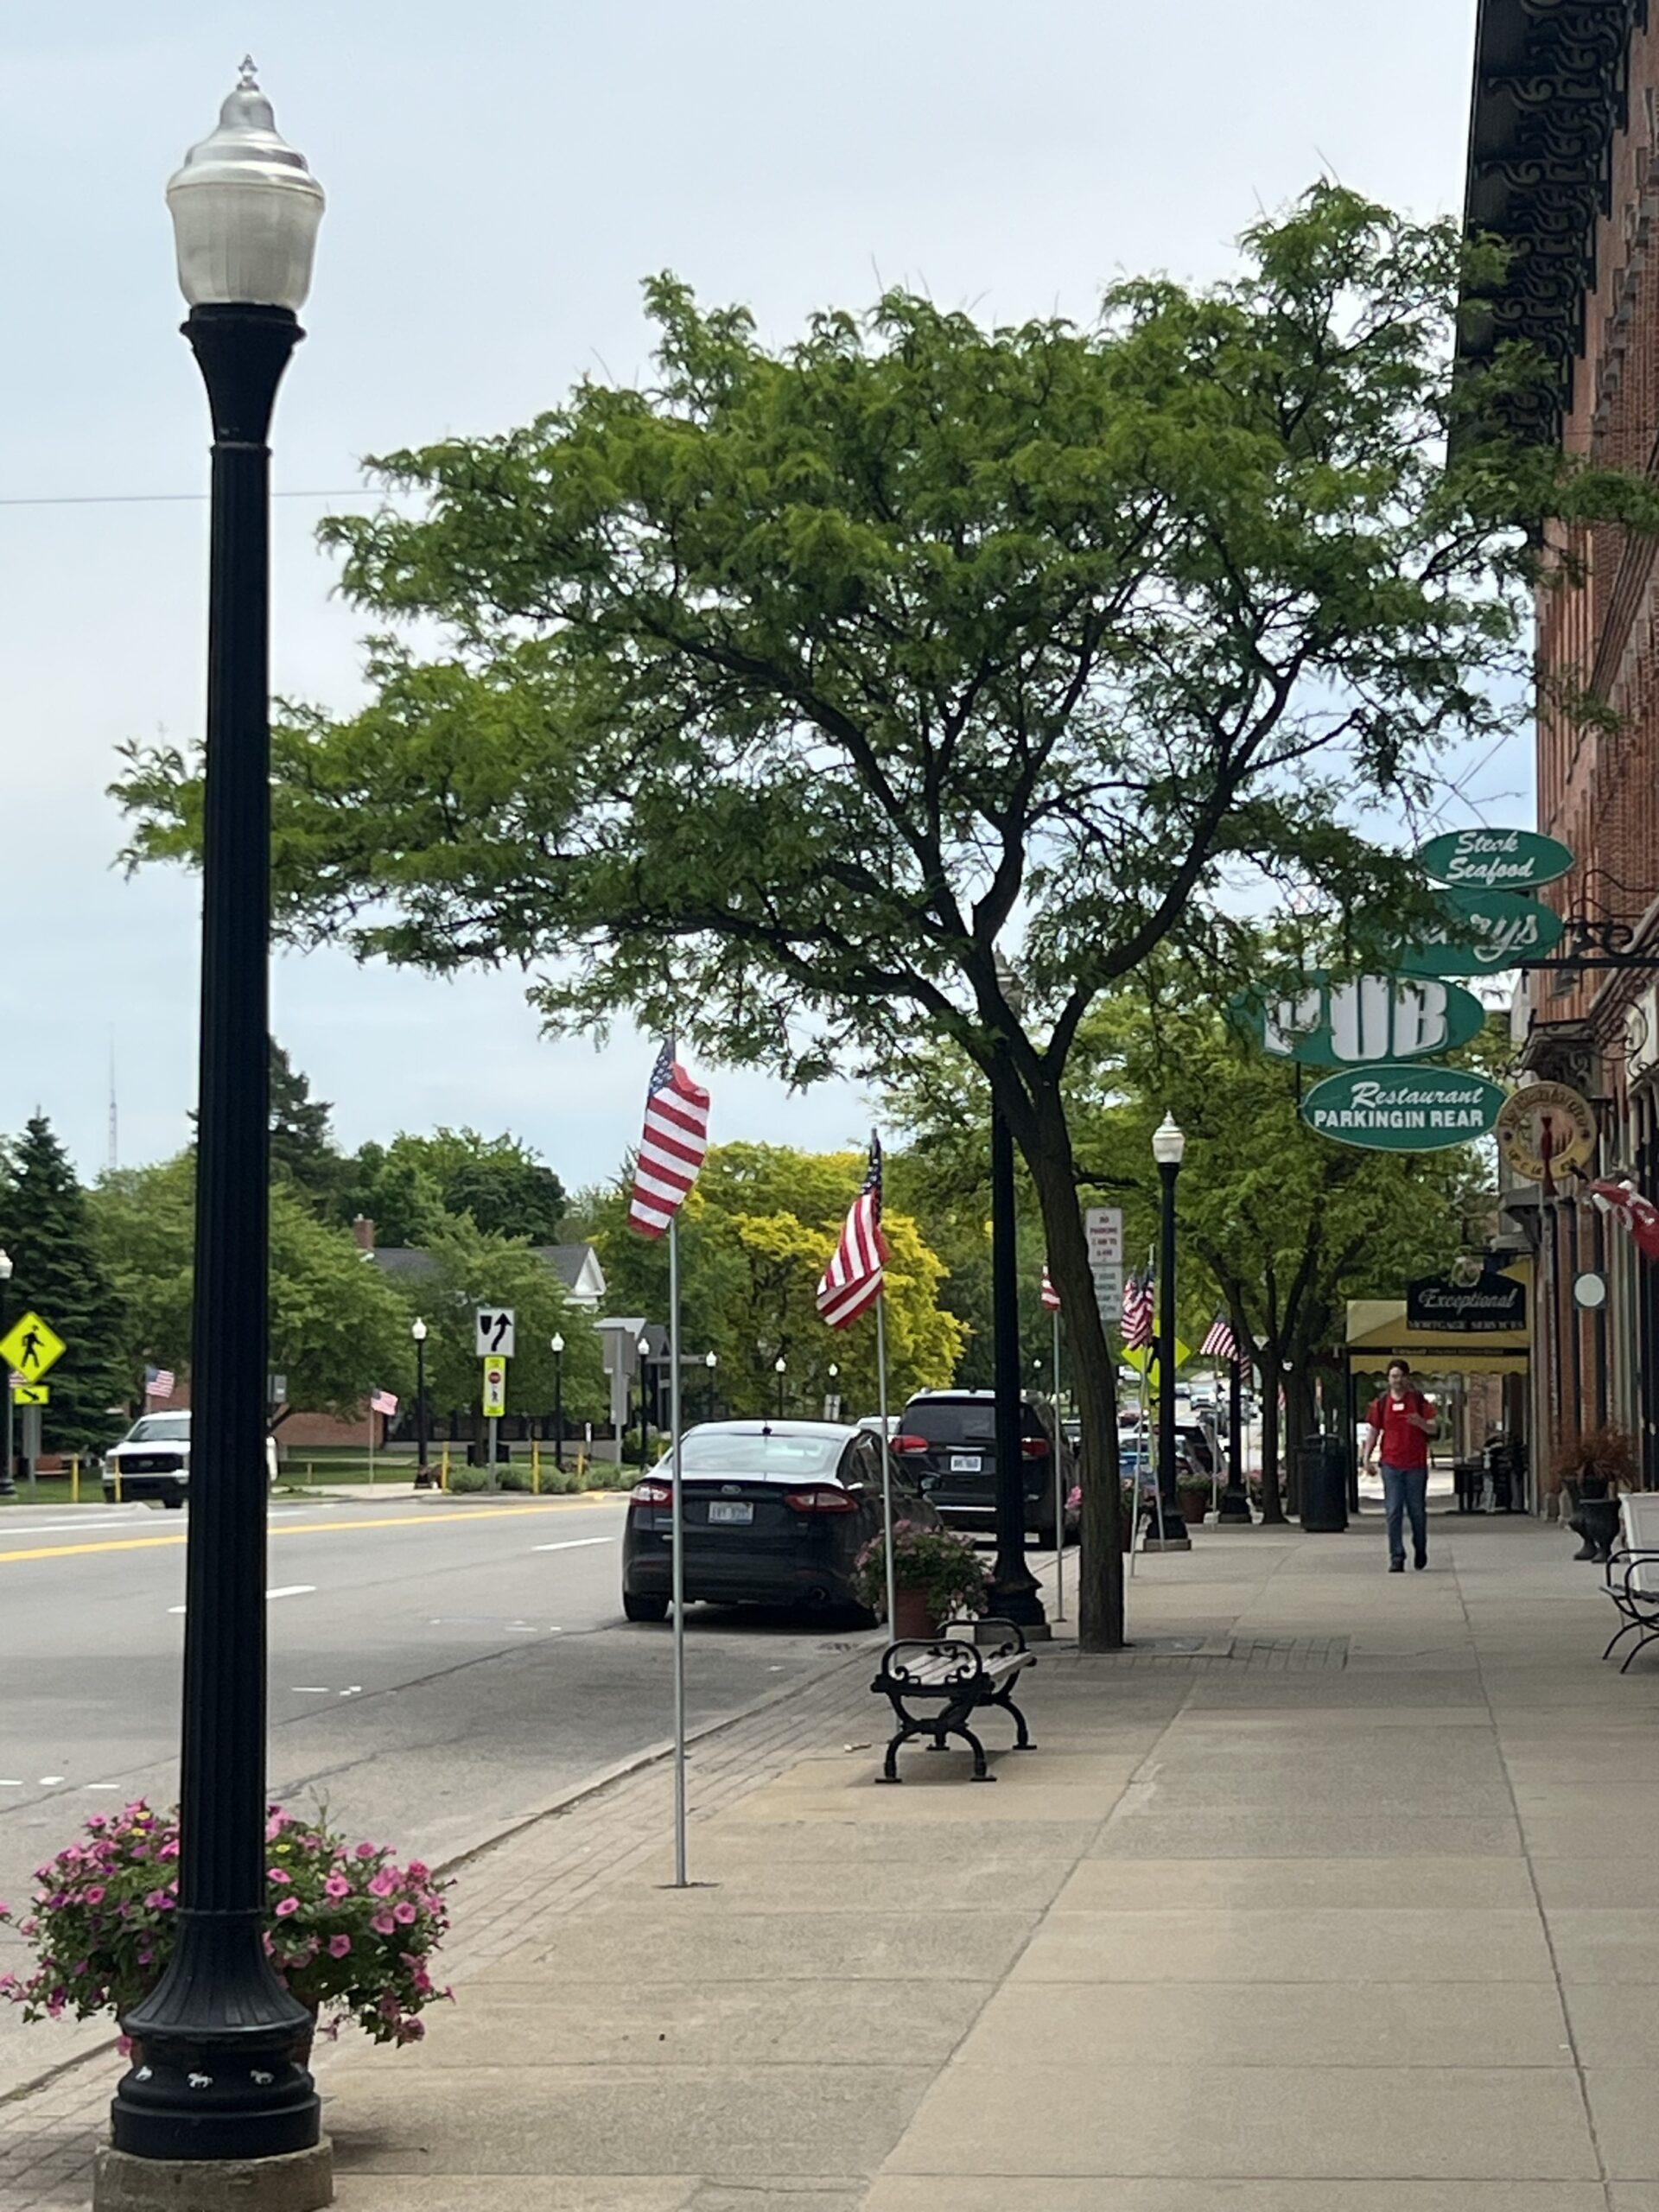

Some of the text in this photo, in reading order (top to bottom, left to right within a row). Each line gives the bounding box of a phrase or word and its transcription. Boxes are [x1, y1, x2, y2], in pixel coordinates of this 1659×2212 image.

[1454, 831, 1519, 854] Steak
[1446, 856, 1535, 886] Seafood
[1264, 974, 1449, 1061] PUB
[1351, 1082, 1484, 1109] Restaurant
[1430, 1109, 1484, 1127] REAR
[1418, 1287, 1518, 1315] Exceptional
